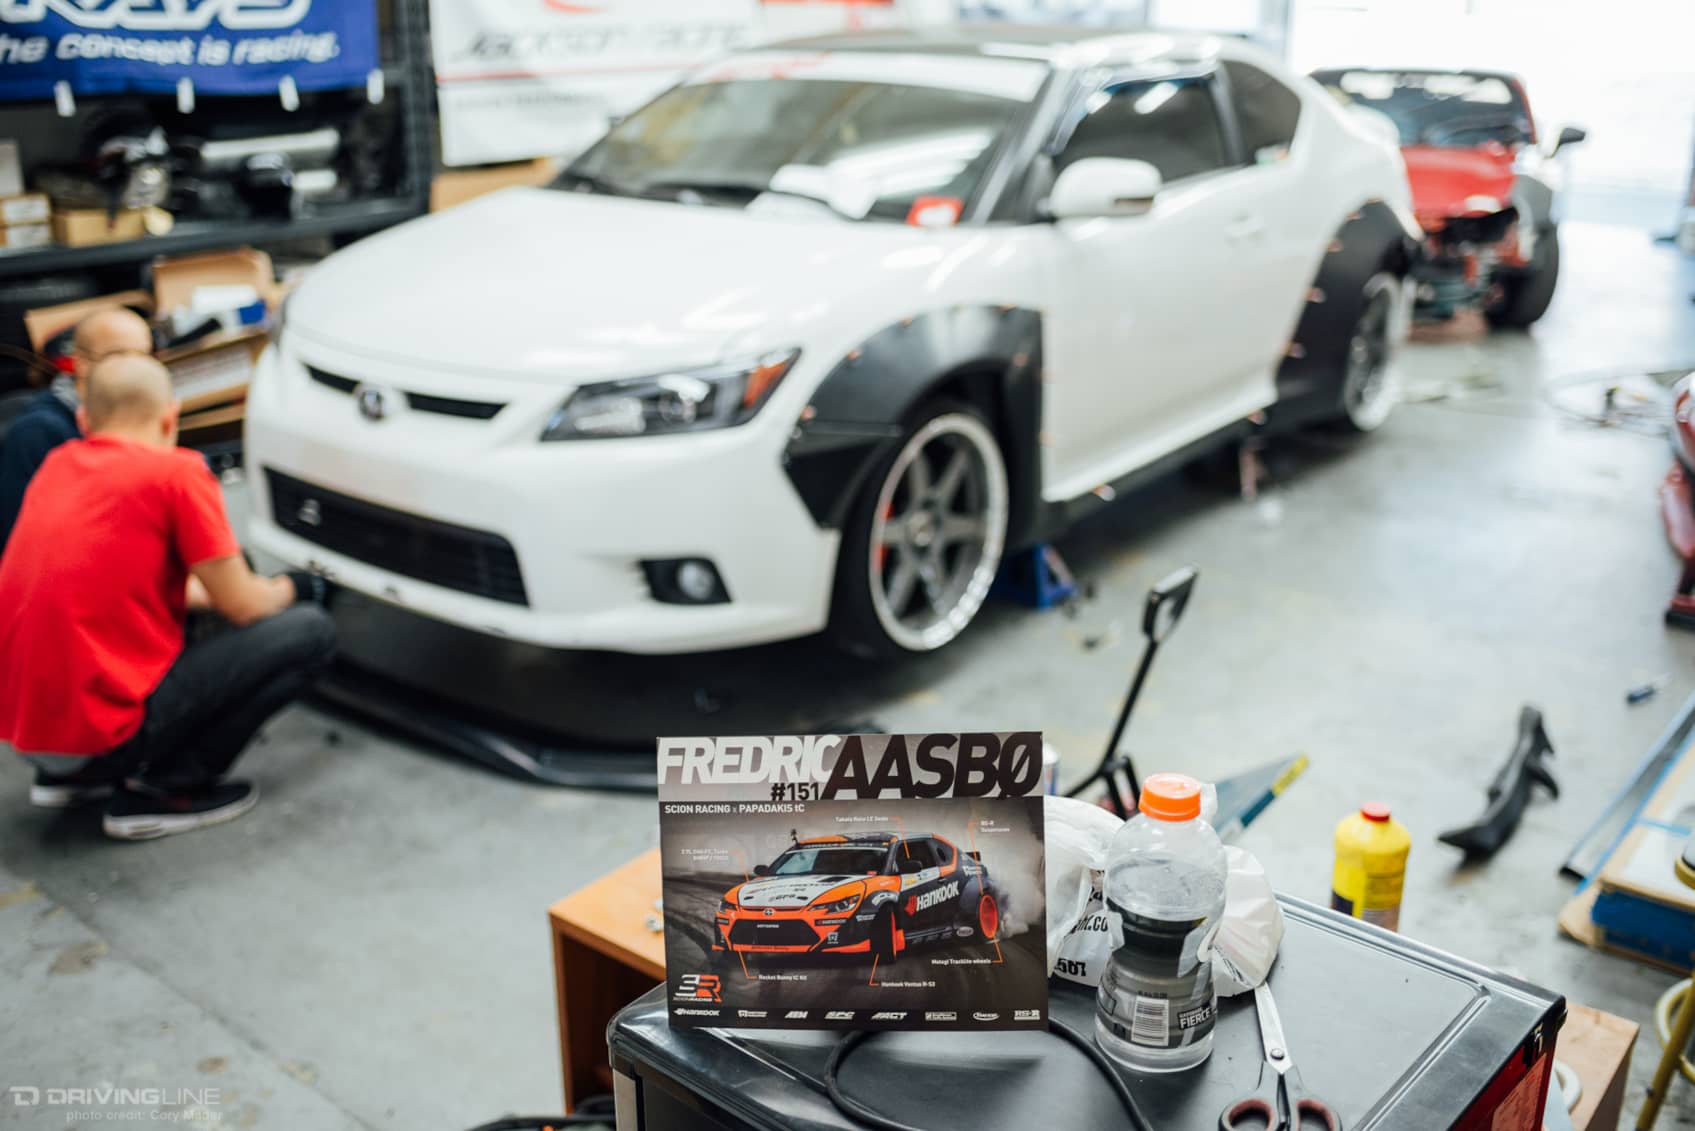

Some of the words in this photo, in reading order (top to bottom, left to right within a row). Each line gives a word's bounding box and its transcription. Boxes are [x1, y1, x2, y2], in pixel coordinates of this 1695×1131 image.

[56, 33, 195, 65] concept
[197, 34, 231, 65] is
[657, 735, 842, 785] FREDRIC
[820, 732, 1043, 800] AASBØ
[770, 782, 820, 801] #151
[664, 804, 696, 814] SCION
[695, 804, 731, 813] RACING
[738, 803, 793, 813] PAPADAKIS
[794, 803, 806, 813] tC
[1180, 1007, 1211, 1029] FIERCE
